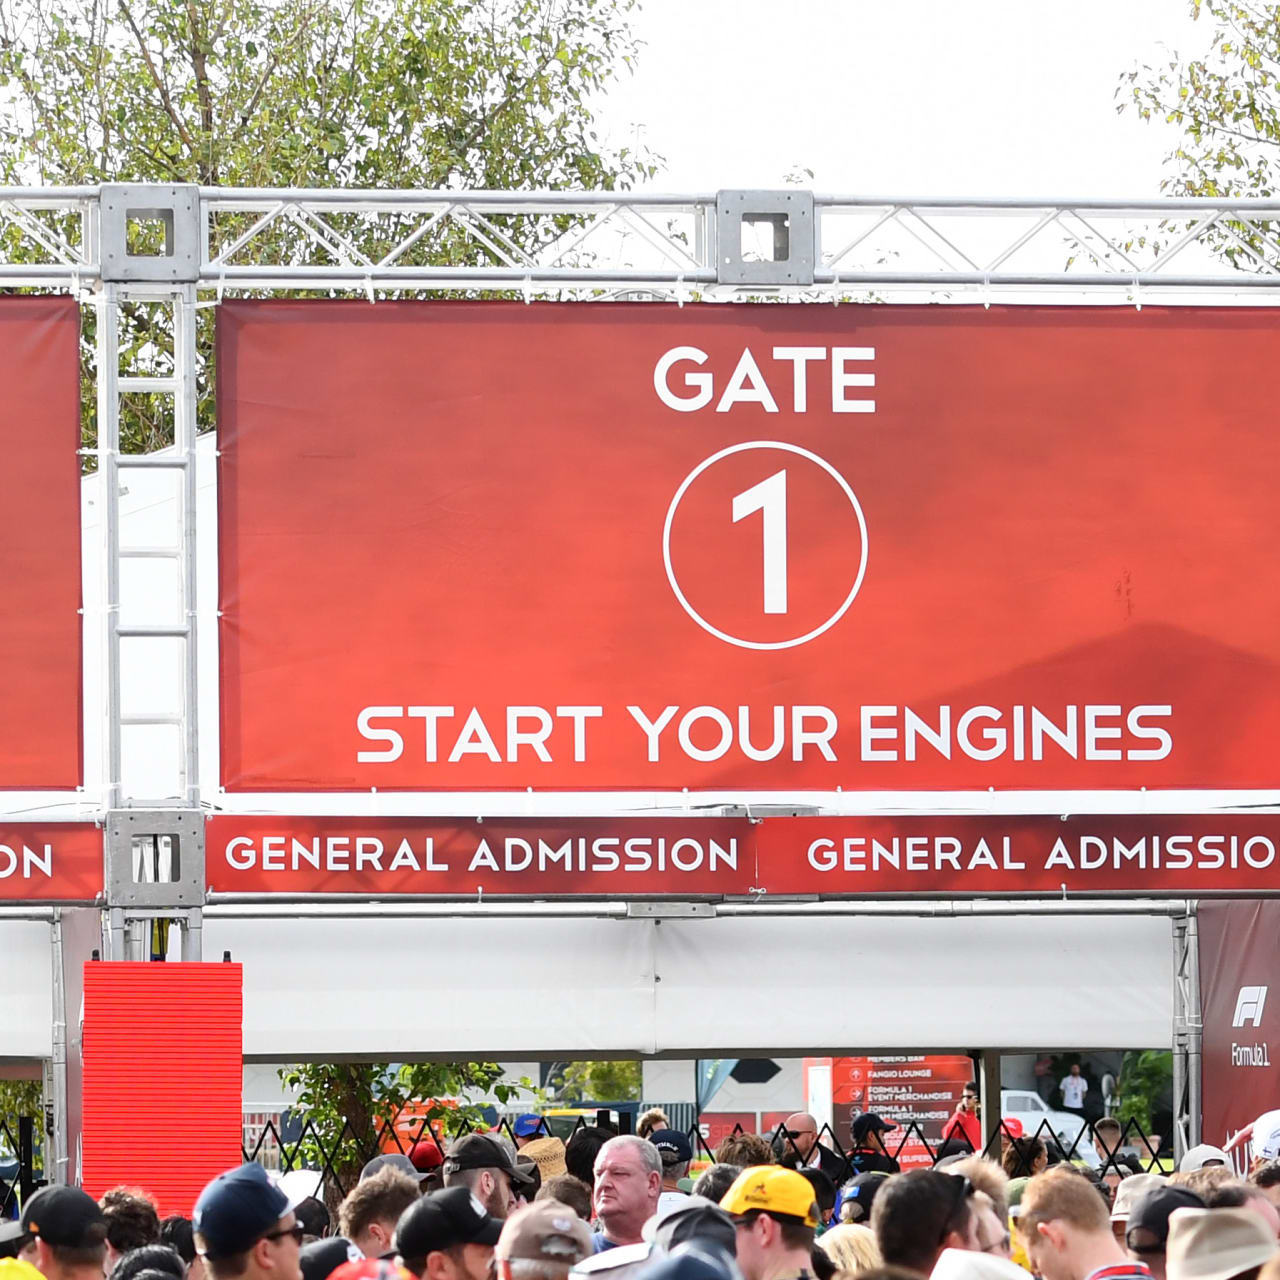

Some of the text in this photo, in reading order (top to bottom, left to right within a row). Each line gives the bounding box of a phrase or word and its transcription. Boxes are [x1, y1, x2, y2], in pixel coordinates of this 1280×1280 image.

[655, 346, 877, 414] GATE
[730, 468, 788, 614] 1
[357, 706, 1174, 764] START YOUR ENGINES
[226, 838, 738, 872] GENERAL ADMISSION
[808, 837, 1027, 873] GENERAL
[867, 1069, 931, 1078] FANGIO LOUNGE
[895, 1092, 952, 1100] MERCHANDISE
[892, 1111, 949, 1119] MERCHANDISE
